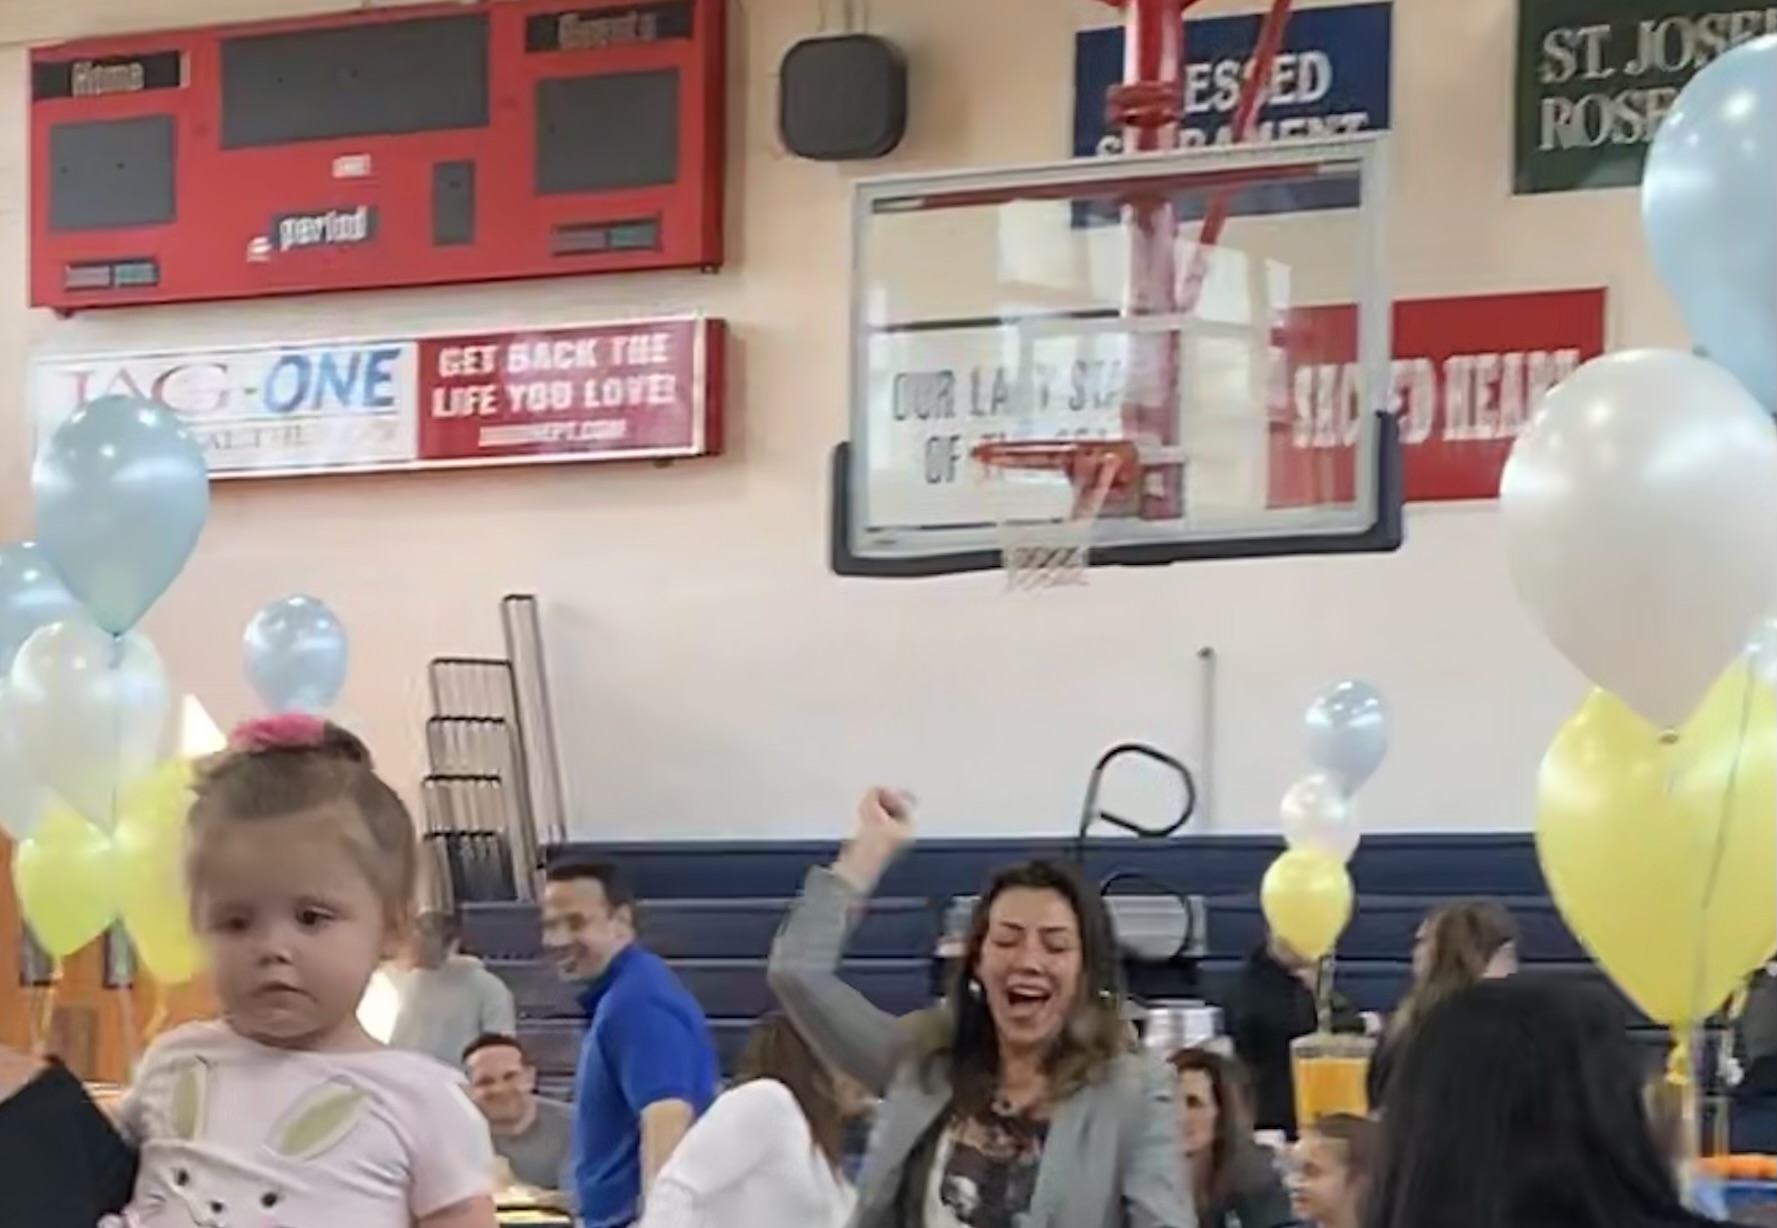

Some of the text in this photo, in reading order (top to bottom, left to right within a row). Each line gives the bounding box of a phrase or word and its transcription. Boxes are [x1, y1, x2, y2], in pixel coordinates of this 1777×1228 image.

[279, 205, 367, 251] period
[438, 333, 670, 378] GET BACK THE
[431, 384, 497, 418] LIFE
[506, 379, 574, 413] YOU
[969, 366, 1051, 417] LAY
